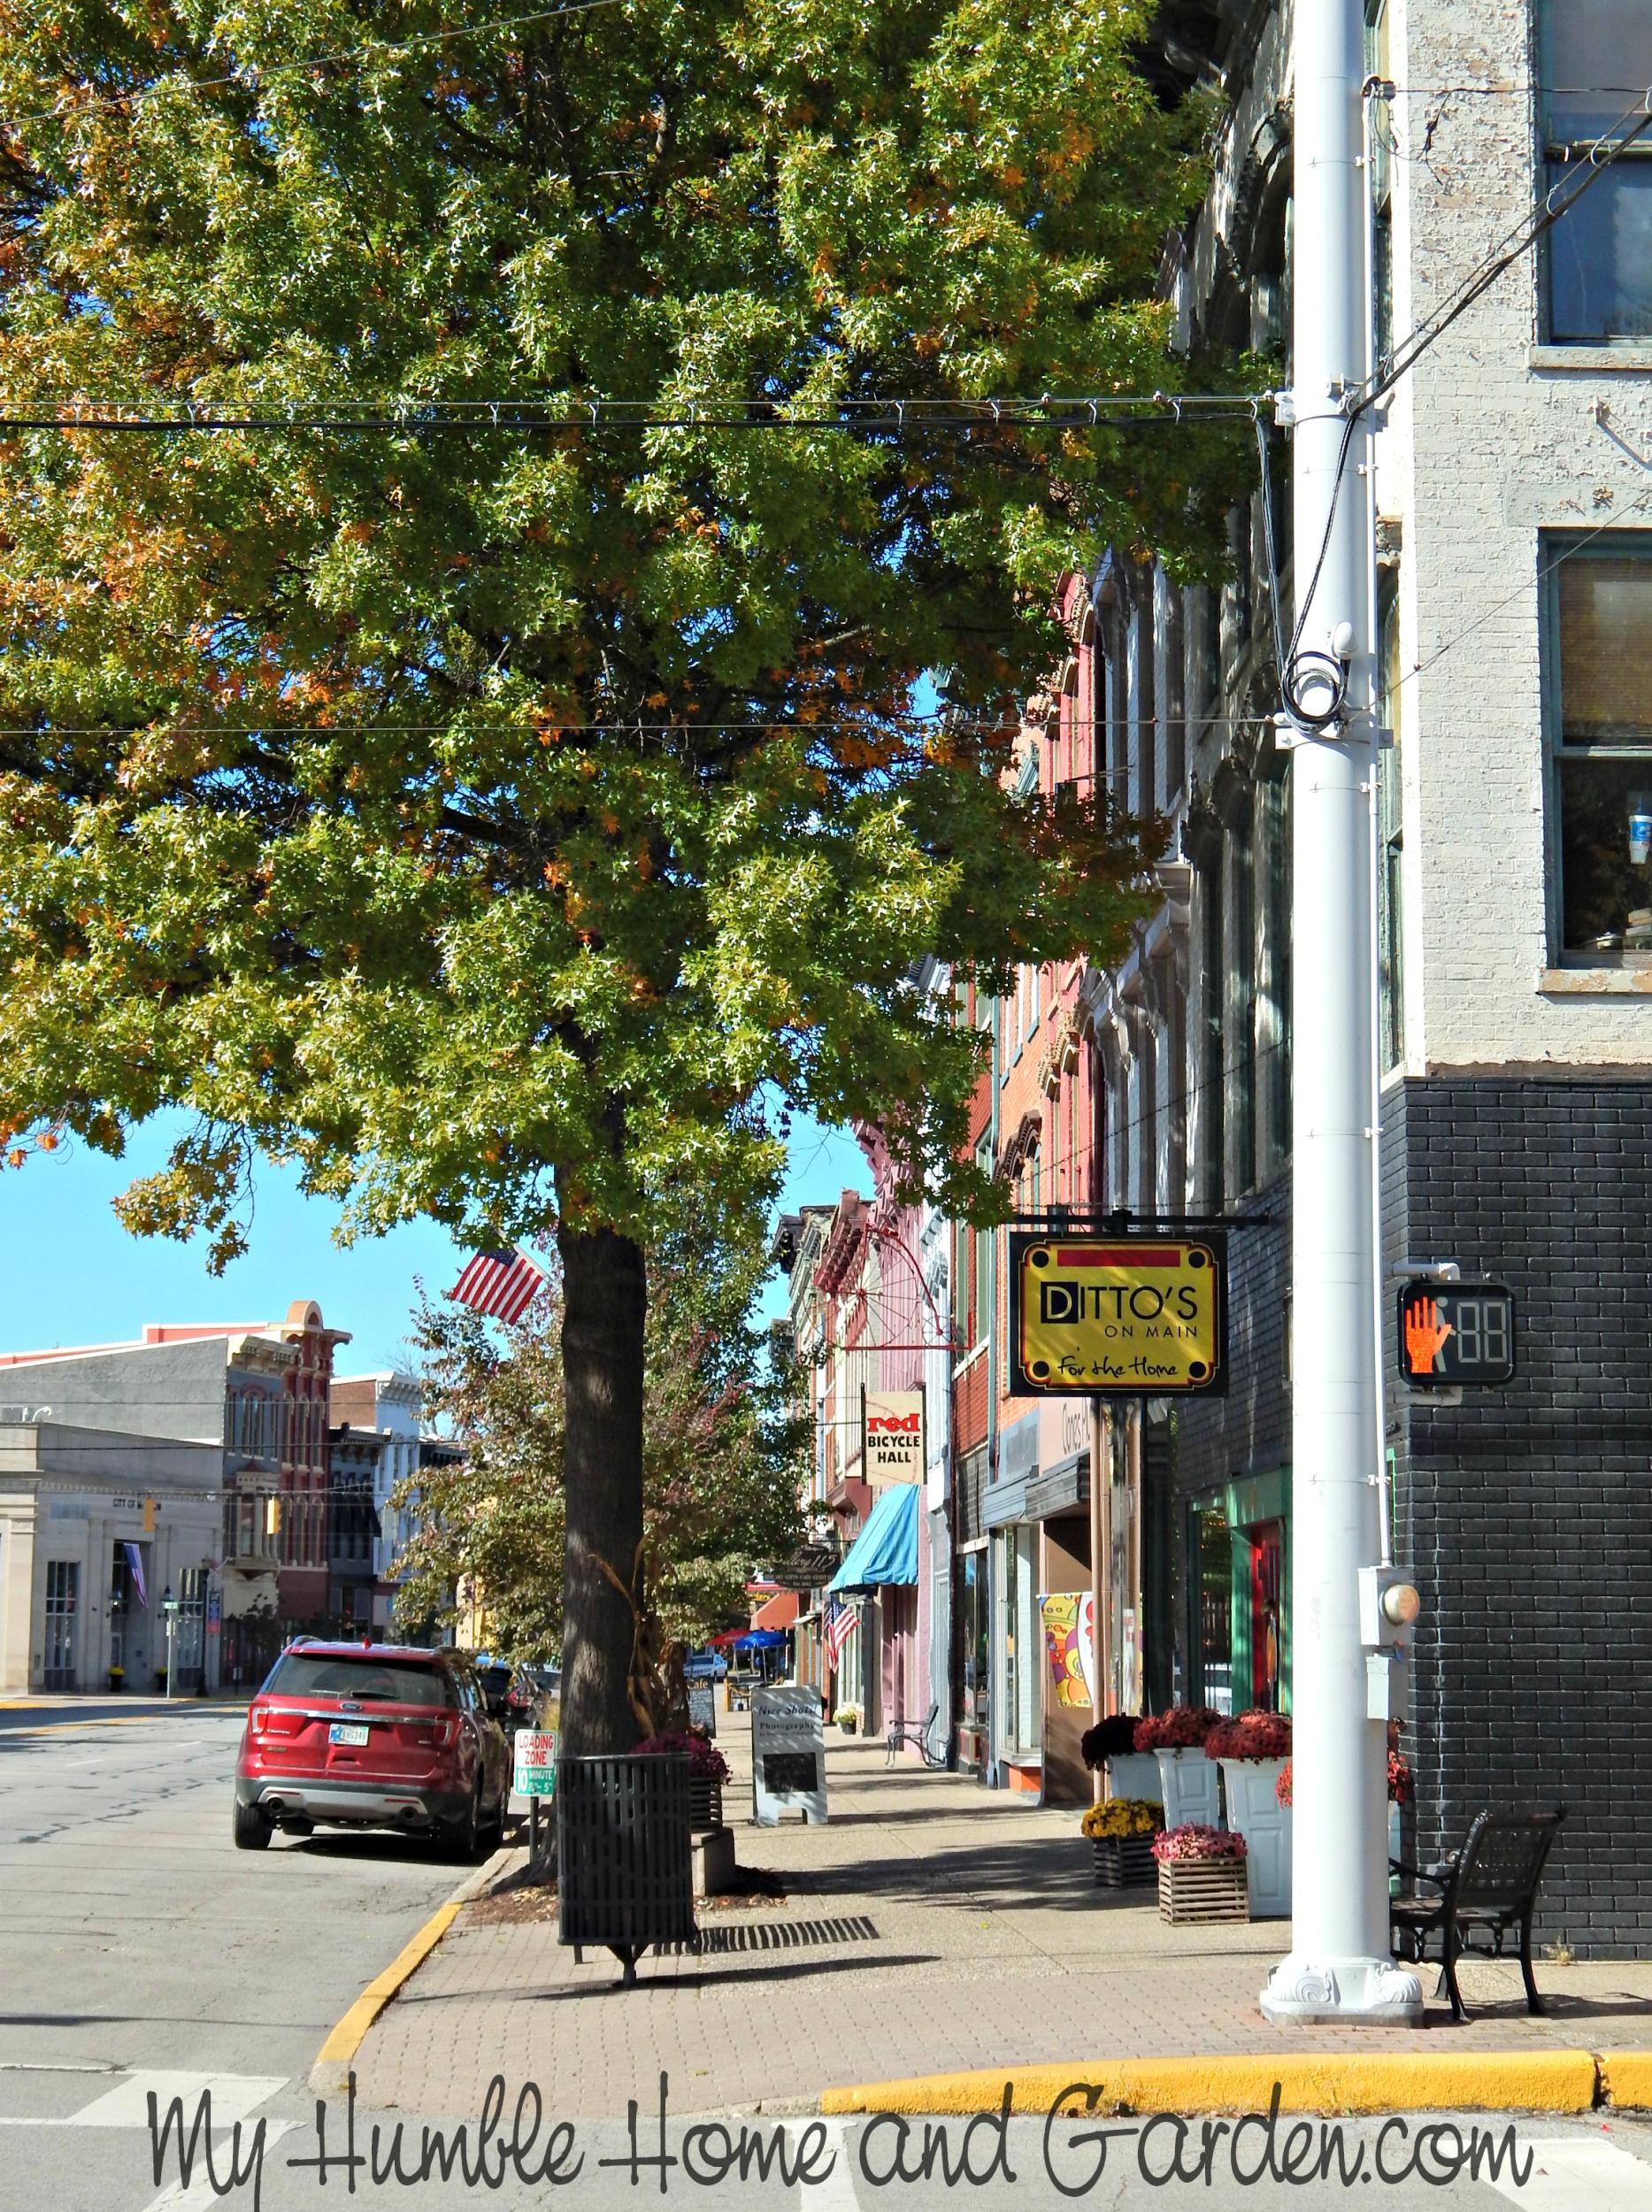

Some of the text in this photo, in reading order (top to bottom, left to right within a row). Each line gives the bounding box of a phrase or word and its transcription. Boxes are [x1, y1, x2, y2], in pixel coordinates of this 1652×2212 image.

[1044, 1285, 1198, 1321] DITTO'S
[1104, 1325, 1197, 1338] ON MAIN
[1057, 1356, 1179, 1379] For the Home
[867, 1413, 921, 1432] red
[867, 1435, 920, 1448] BICYCLE
[877, 1451, 911, 1463] HALL
[757, 1705, 781, 1716] Nice
[759, 1721, 815, 1732] Photography
[519, 1734, 553, 1749] LOADING
[525, 1750, 547, 1765] ZONE
[518, 1769, 528, 1793] 10
[529, 1770, 553, 1780] MINUTE
